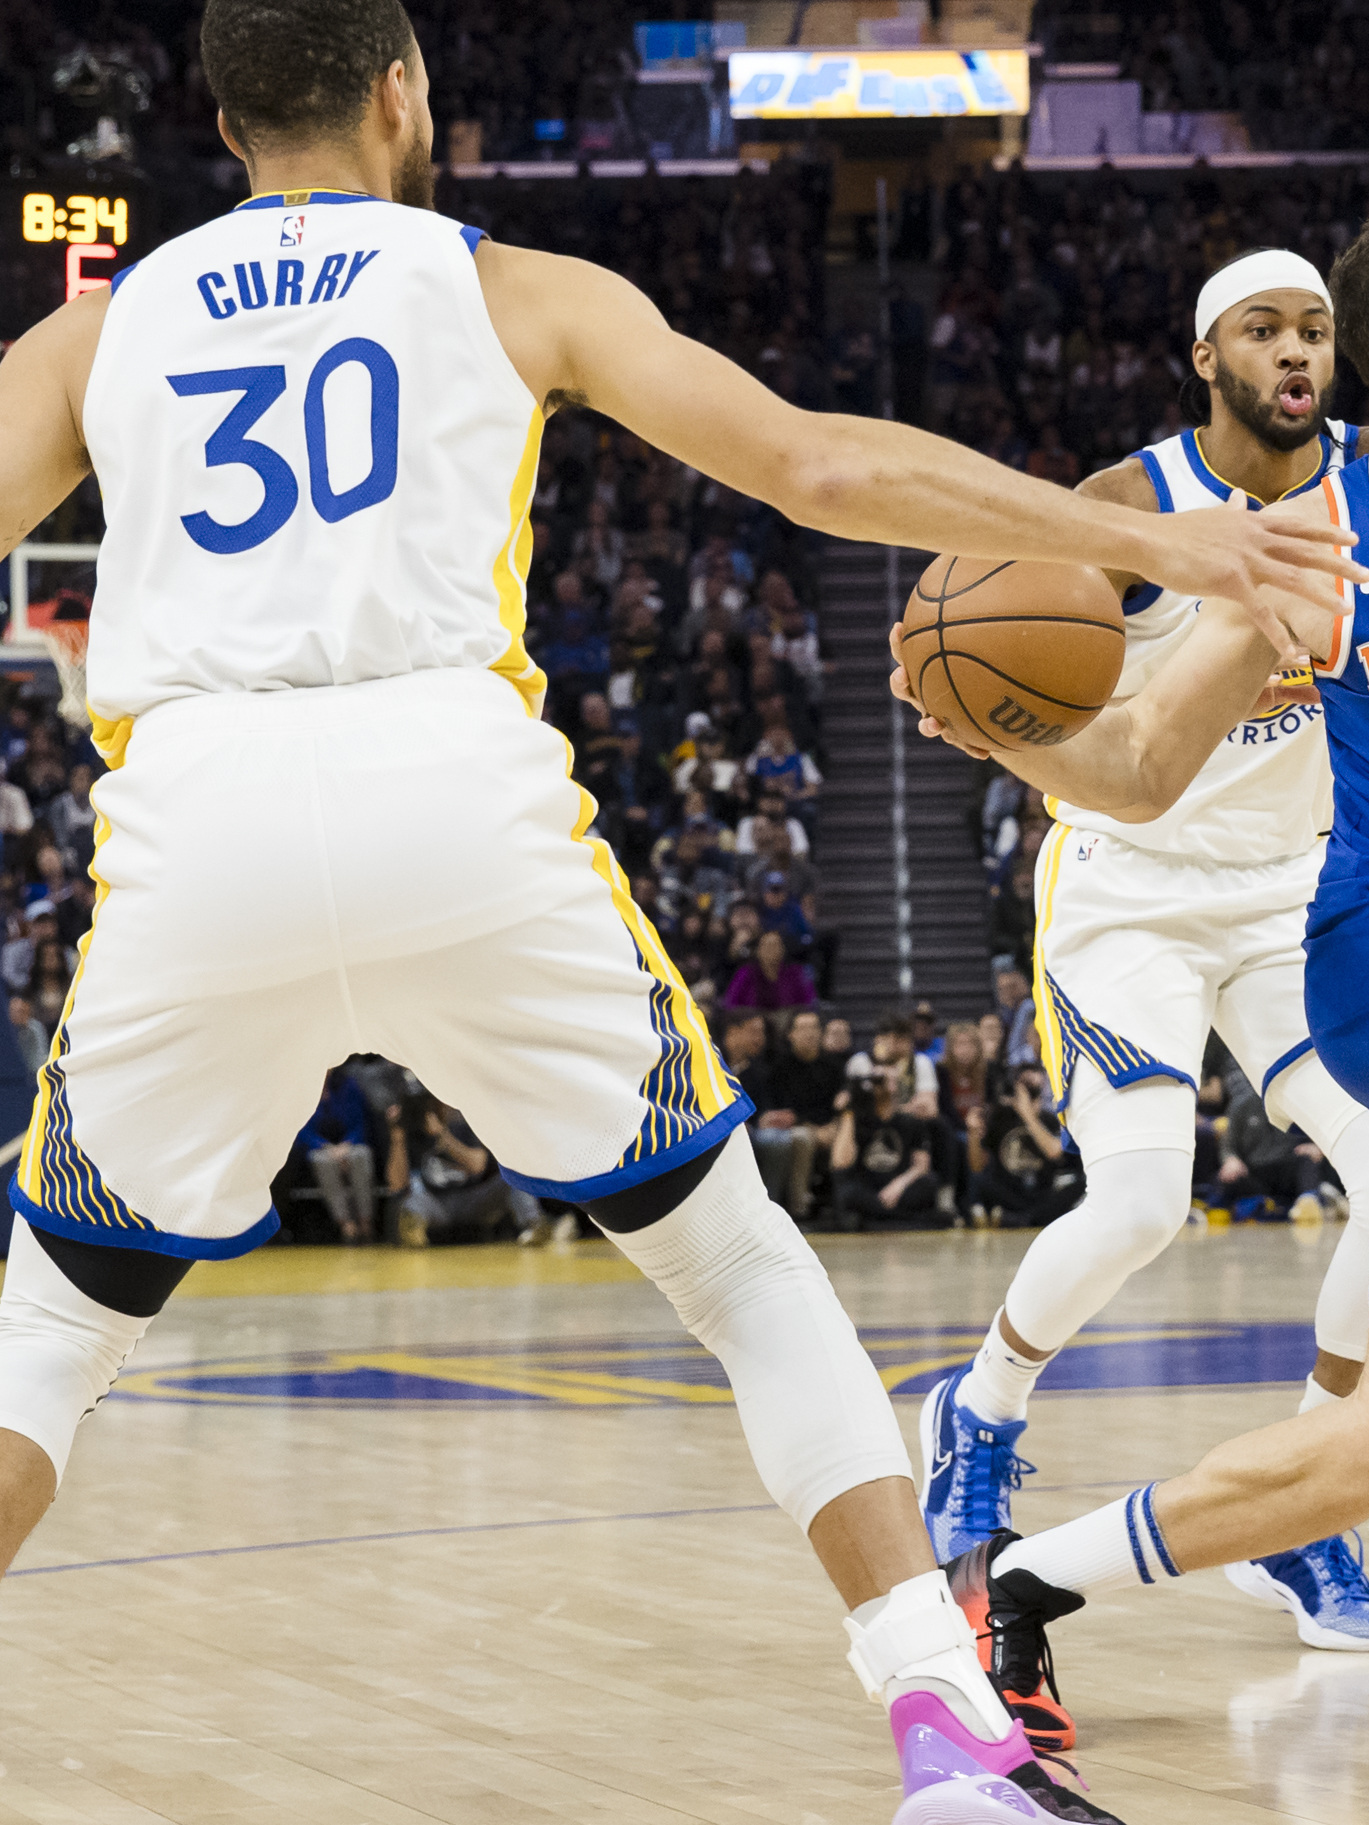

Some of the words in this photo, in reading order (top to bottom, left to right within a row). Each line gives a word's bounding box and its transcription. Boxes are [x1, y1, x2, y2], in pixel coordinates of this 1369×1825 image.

[23, 193, 128, 245] 8:34
[197, 249, 381, 320] CURRY
[165, 337, 399, 554] 30
